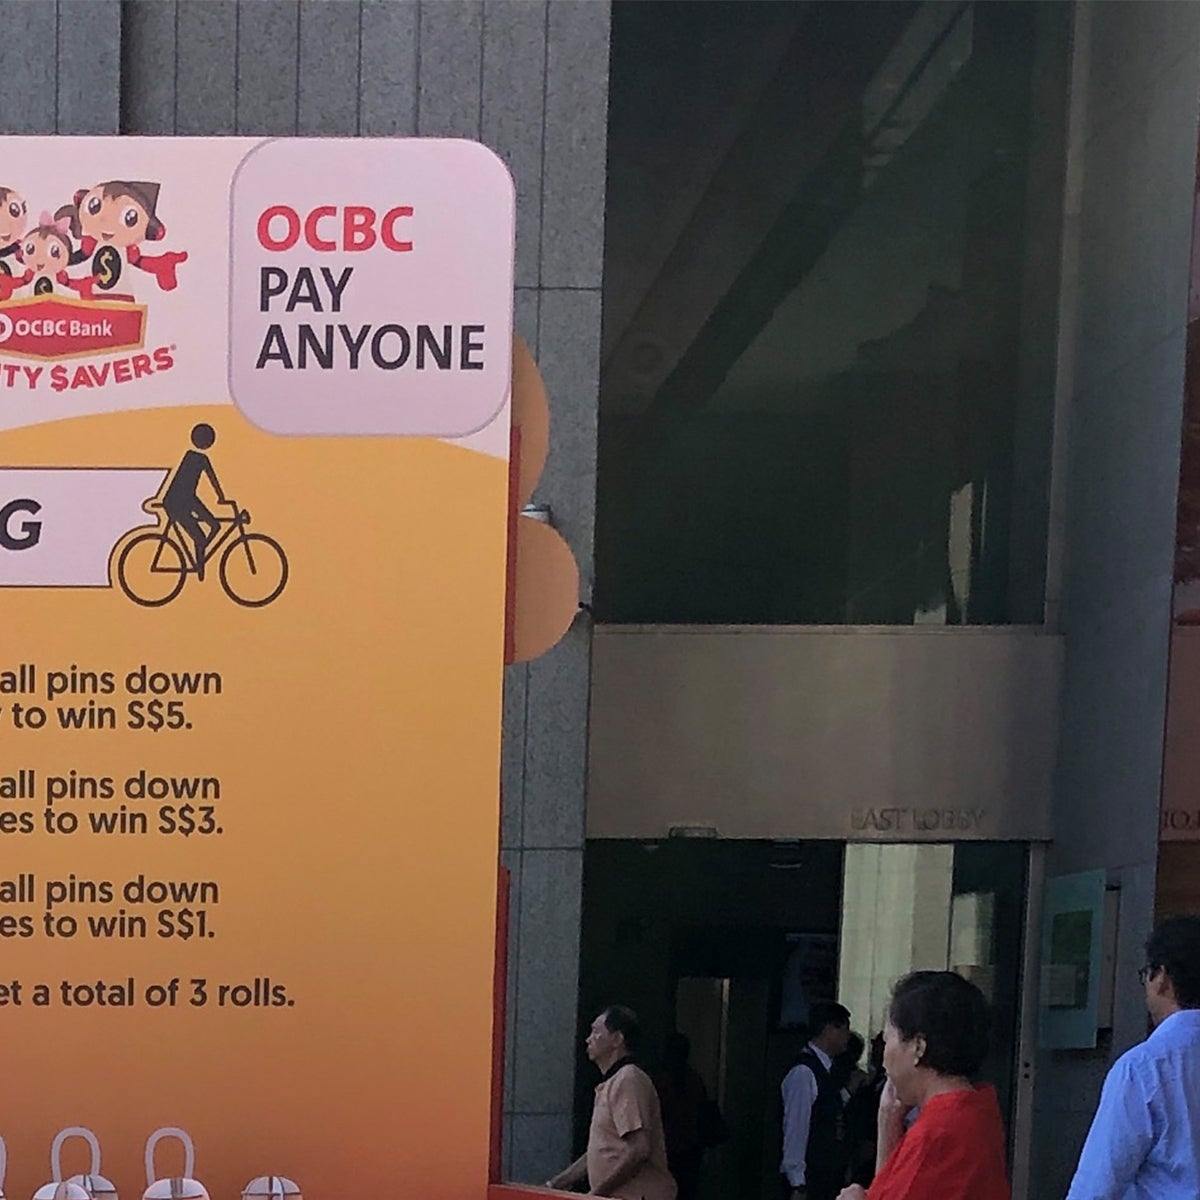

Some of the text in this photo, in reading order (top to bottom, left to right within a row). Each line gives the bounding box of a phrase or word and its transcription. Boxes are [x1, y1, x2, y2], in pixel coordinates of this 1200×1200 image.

[259, 207, 411, 250] OCBC
[261, 267, 353, 312] PAY
[14, 319, 112, 338] OCBC Bank
[256, 324, 484, 369] ANYONE
[0, 664, 34, 693] all
[48, 665, 114, 704] pins
[126, 665, 221, 694] down
[12, 703, 46, 728] to
[57, 700, 115, 728] win
[128, 699, 192, 732] S$5.
[0, 770, 34, 798] all
[47, 770, 114, 805] pins
[125, 770, 219, 798] down
[44, 808, 77, 833] to
[89, 805, 146, 833] win
[159, 804, 222, 837] S$3.
[851, 809, 907, 831] EAST
[0, 874, 34, 903] all
[47, 874, 113, 909] pins
[124, 875, 218, 903] down
[44, 912, 77, 937] to
[88, 910, 145, 937] win
[158, 908, 214, 940] S$1.
[33, 985, 49, 1006] a
[61, 978, 133, 1006] total
[146, 978, 179, 1006] of
[190, 979, 207, 1006] 3
[219, 978, 294, 1006] rolls.
